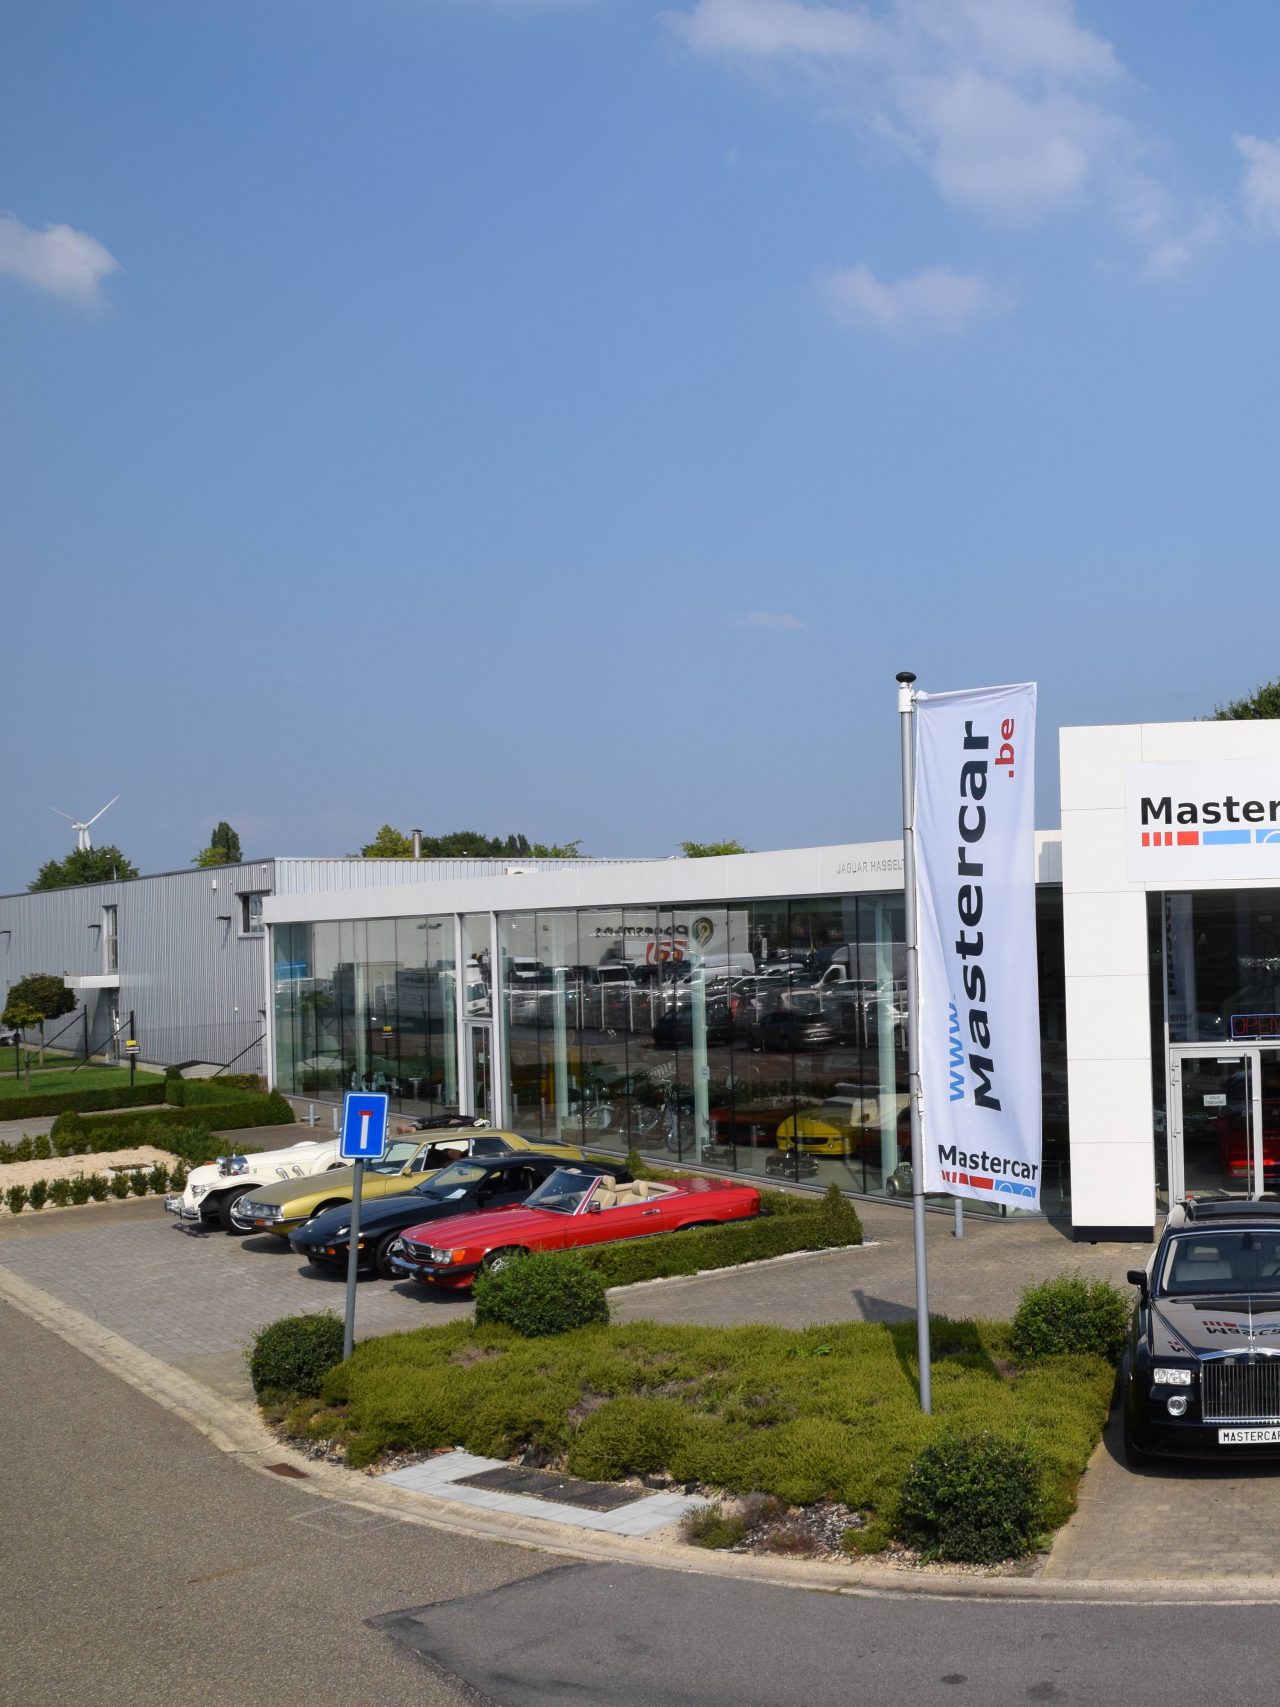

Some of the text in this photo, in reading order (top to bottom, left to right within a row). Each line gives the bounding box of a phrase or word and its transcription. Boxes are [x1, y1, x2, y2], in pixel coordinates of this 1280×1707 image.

[995, 718, 1015, 778] .be
[837, 861, 868, 874] JAGUAR
[955, 720, 1002, 1112] Mastercar
[1234, 1015, 1280, 1034] OPEN
[949, 1001, 965, 1102] www
[938, 1144, 1039, 1181] Mastercar
